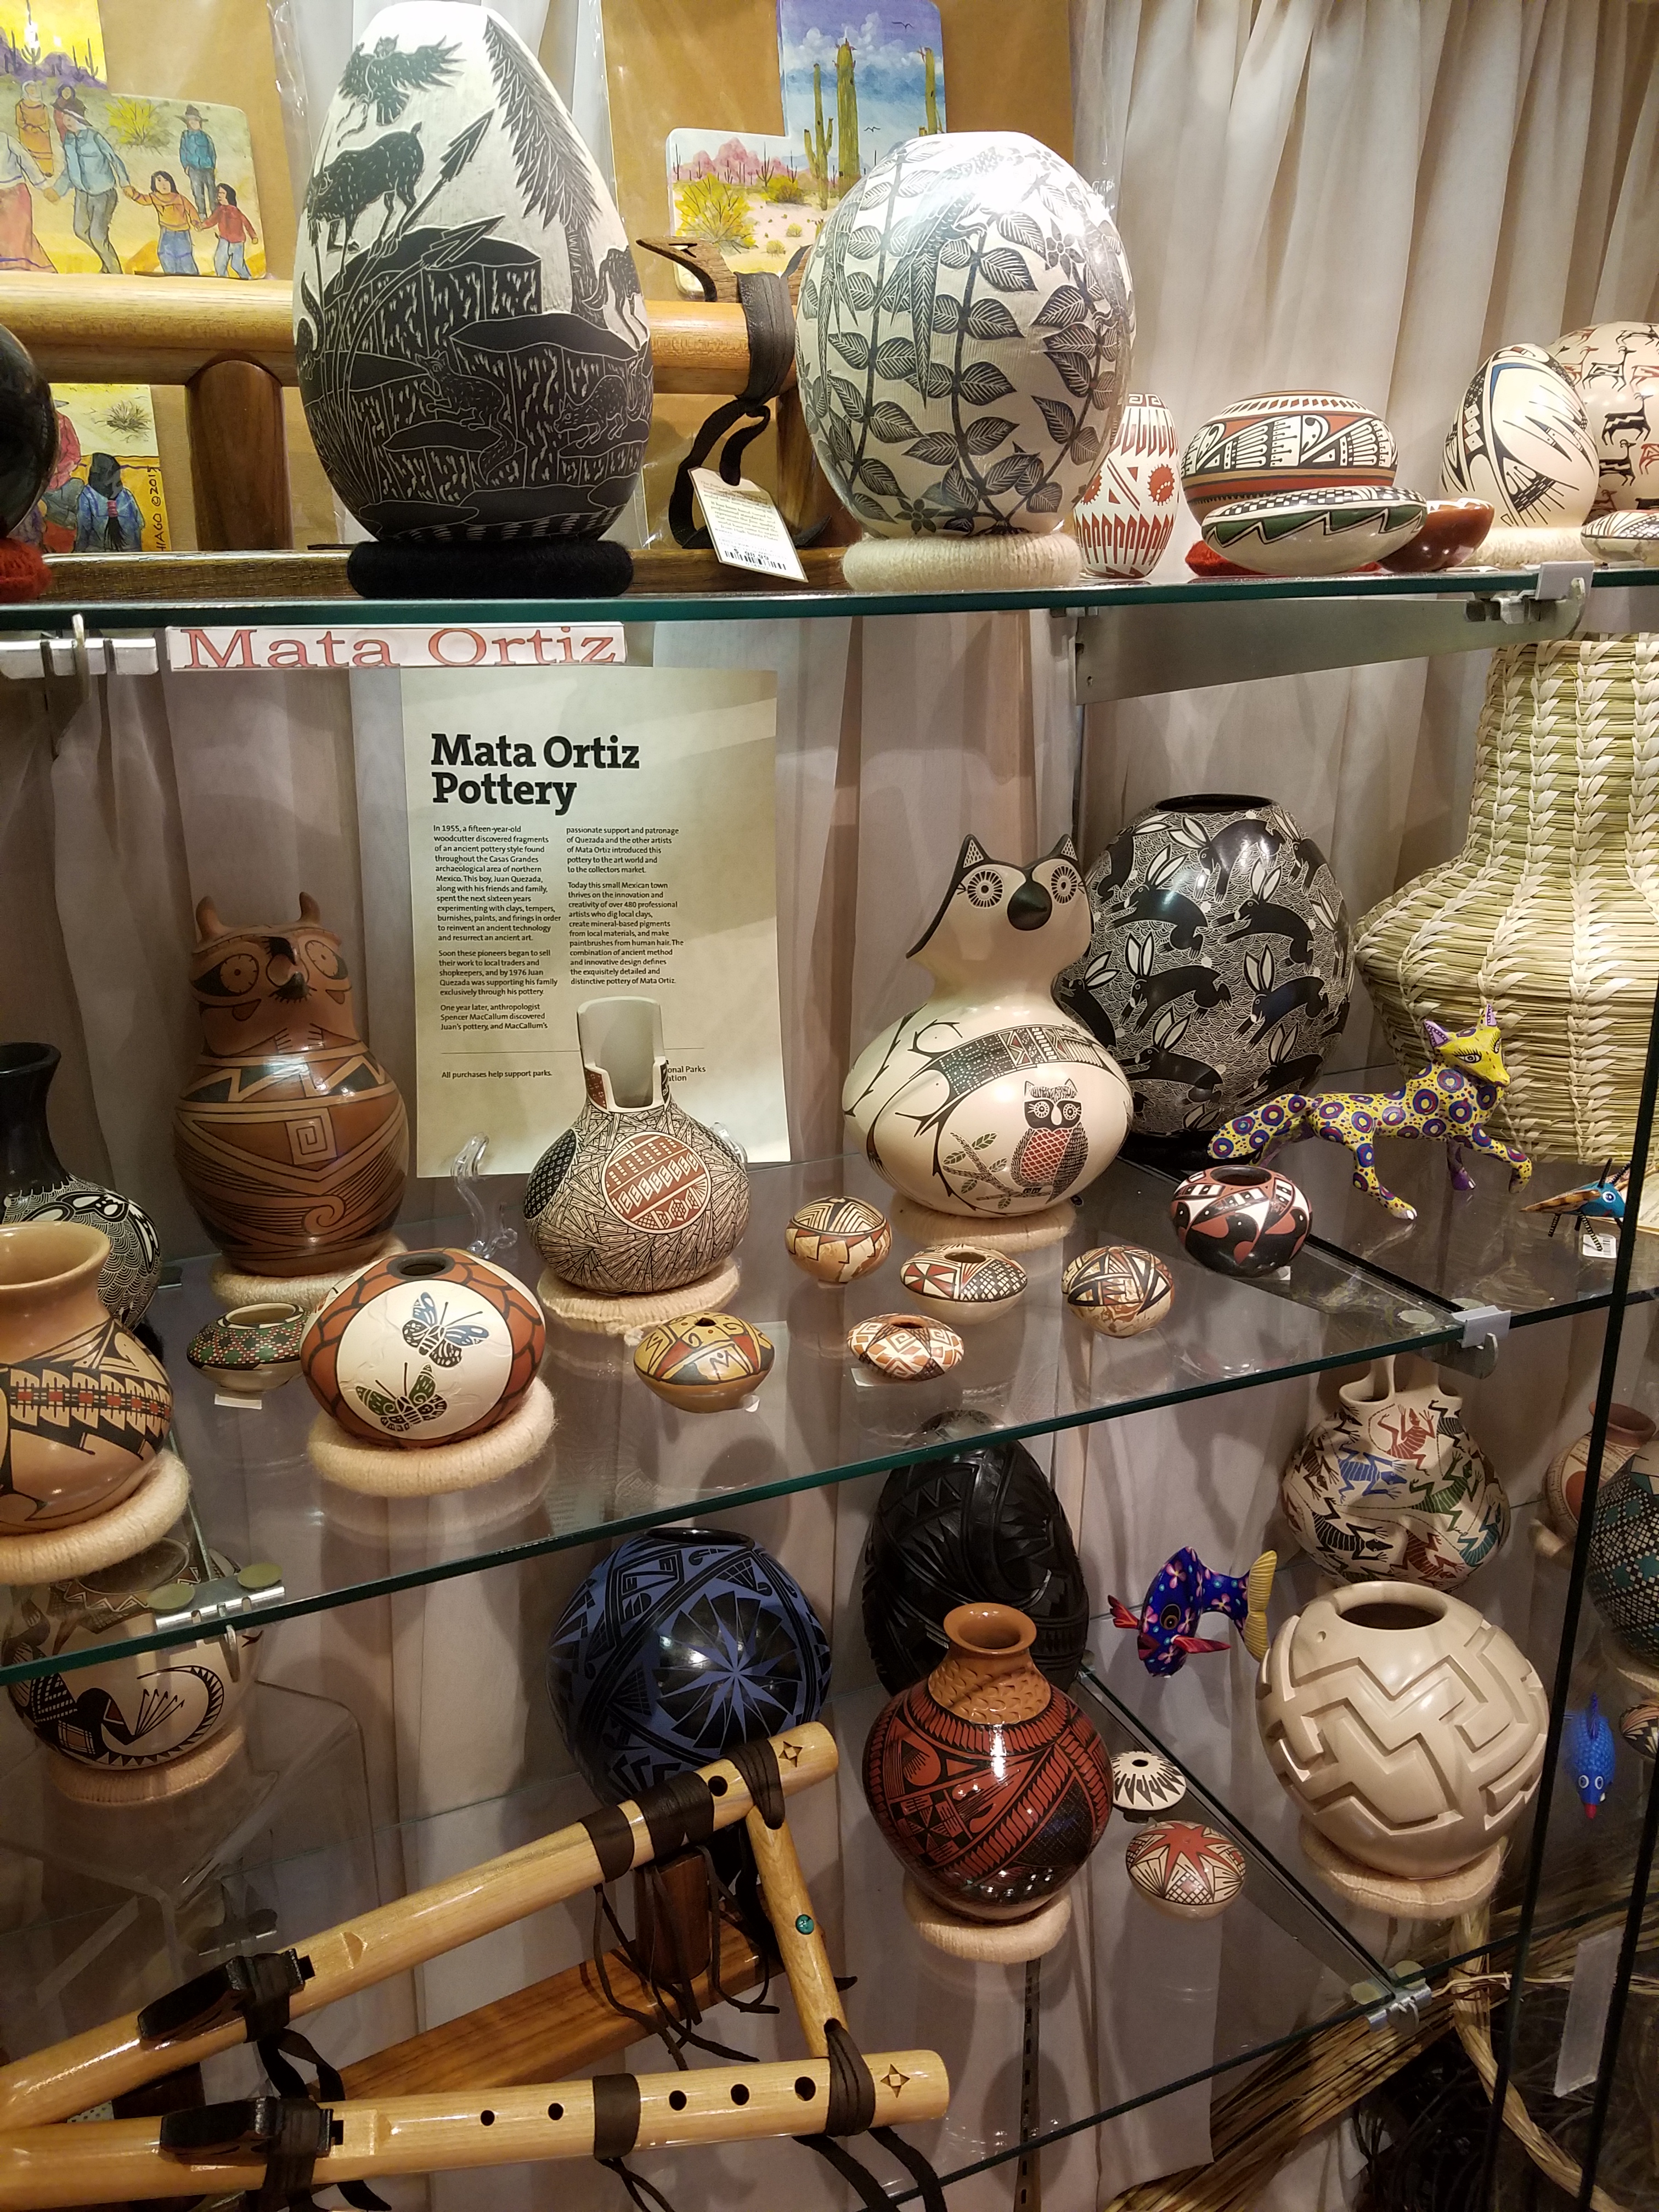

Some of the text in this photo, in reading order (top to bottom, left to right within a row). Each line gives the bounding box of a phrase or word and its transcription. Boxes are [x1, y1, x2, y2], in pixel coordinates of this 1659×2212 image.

[153, 513, 166, 551] HIAGO
[180, 627, 617, 668] Mata Ortiz
[431, 733, 640, 769] Mata Ortiz
[431, 771, 578, 816] Pottery
[469, 825, 521, 834] fifteen-year-old
[566, 827, 602, 835] passionate
[645, 827, 679, 836] patronage
[513, 836, 549, 844] fragments
[481, 846, 506, 854] pottery
[507, 846, 523, 854] style
[435, 855, 475, 864] throughout
[567, 856, 592, 865] pottery
[435, 865, 485, 874] archaeological
[436, 884, 456, 894] along
[525, 885, 548, 894] family,
[567, 882, 588, 890] Today
[568, 901, 600, 910] creativity
[637, 901, 678, 909] professional
[607, 911, 618, 919] dig
[635, 910, 653, 919] clays,
[512, 924, 551, 933] technology
[640, 921, 670, 929] pigments
[569, 940, 613, 948] paintbrushes
[508, 950, 529, 958] began
[439, 969, 484, 978] shopkeepers,
[499, 969, 508, 978] by
[583, 968, 619, 977] exquisitely
[440, 989, 477, 997] exclusively
[478, 988, 506, 997] through
[490, 1003, 540, 1012] anthropologist
[441, 1014, 469, 1022] Spencer
[452, 1071, 487, 1080] purchases
[505, 1070, 532, 1079] support
